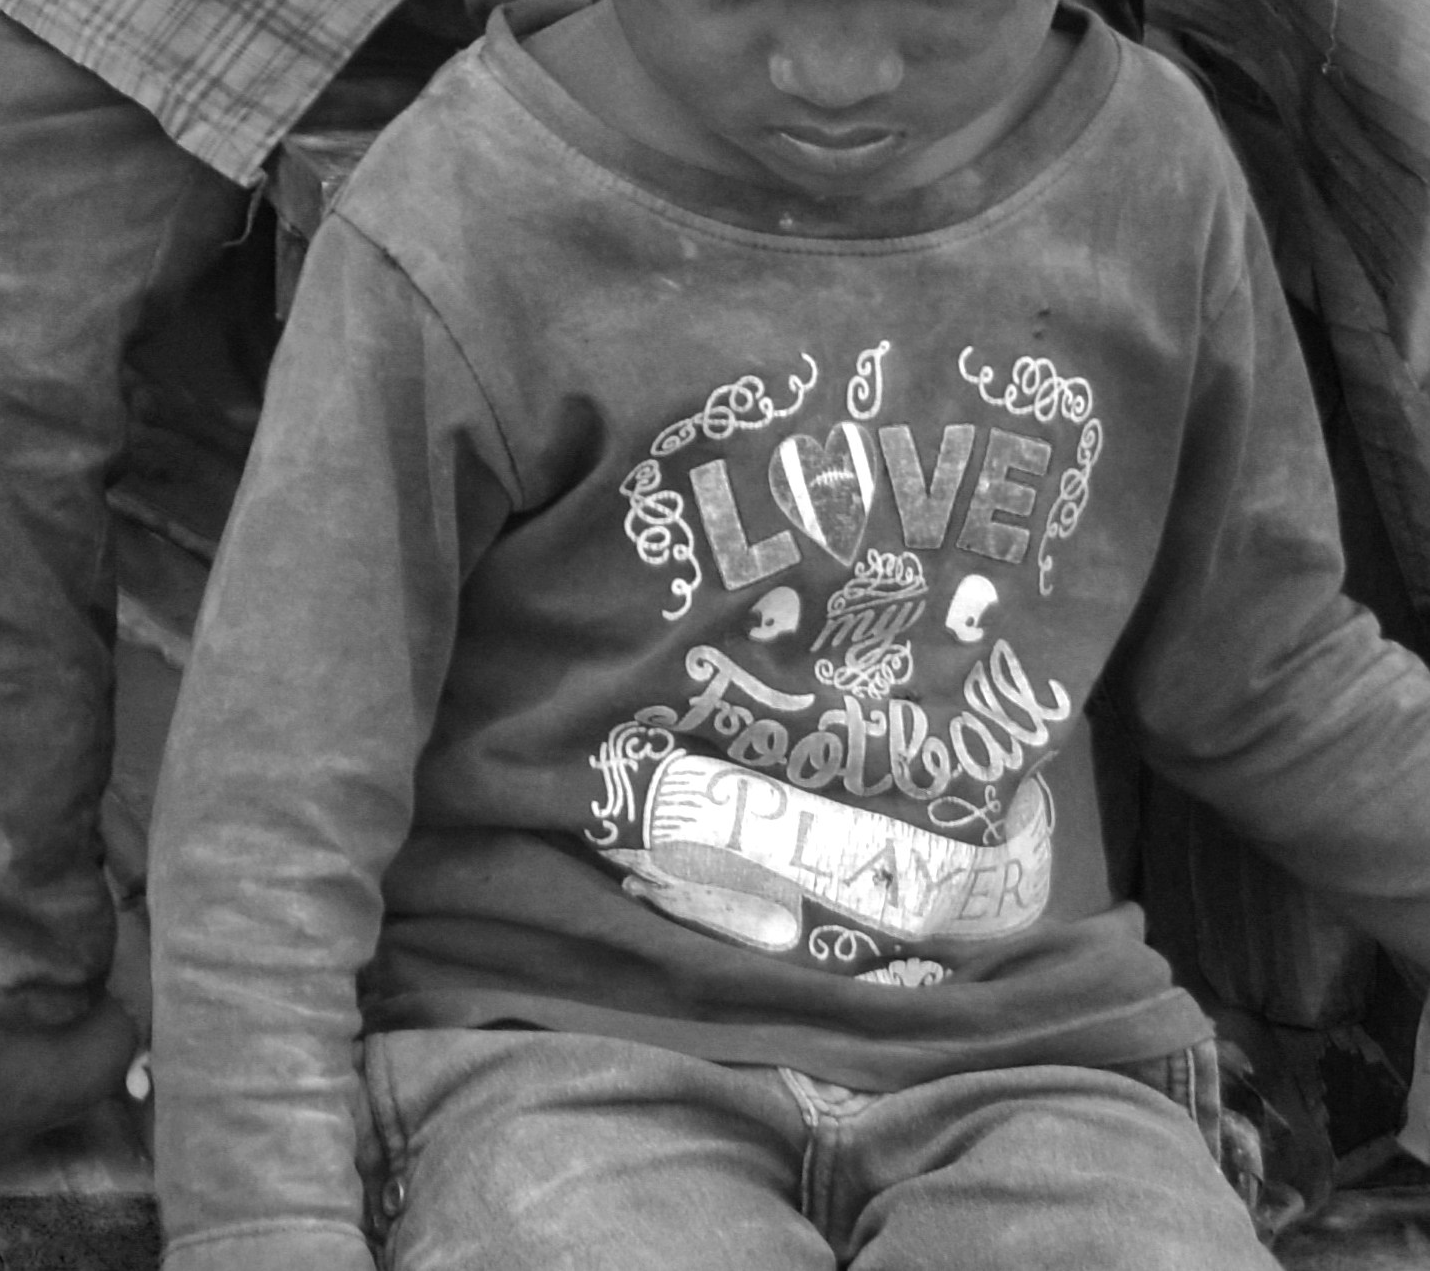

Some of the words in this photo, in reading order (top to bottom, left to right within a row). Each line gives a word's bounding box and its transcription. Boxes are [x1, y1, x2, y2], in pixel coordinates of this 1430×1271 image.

[810, 599, 927, 653] my
[634, 638, 1071, 800] Football
[707, 766, 1029, 922] PLAYER
